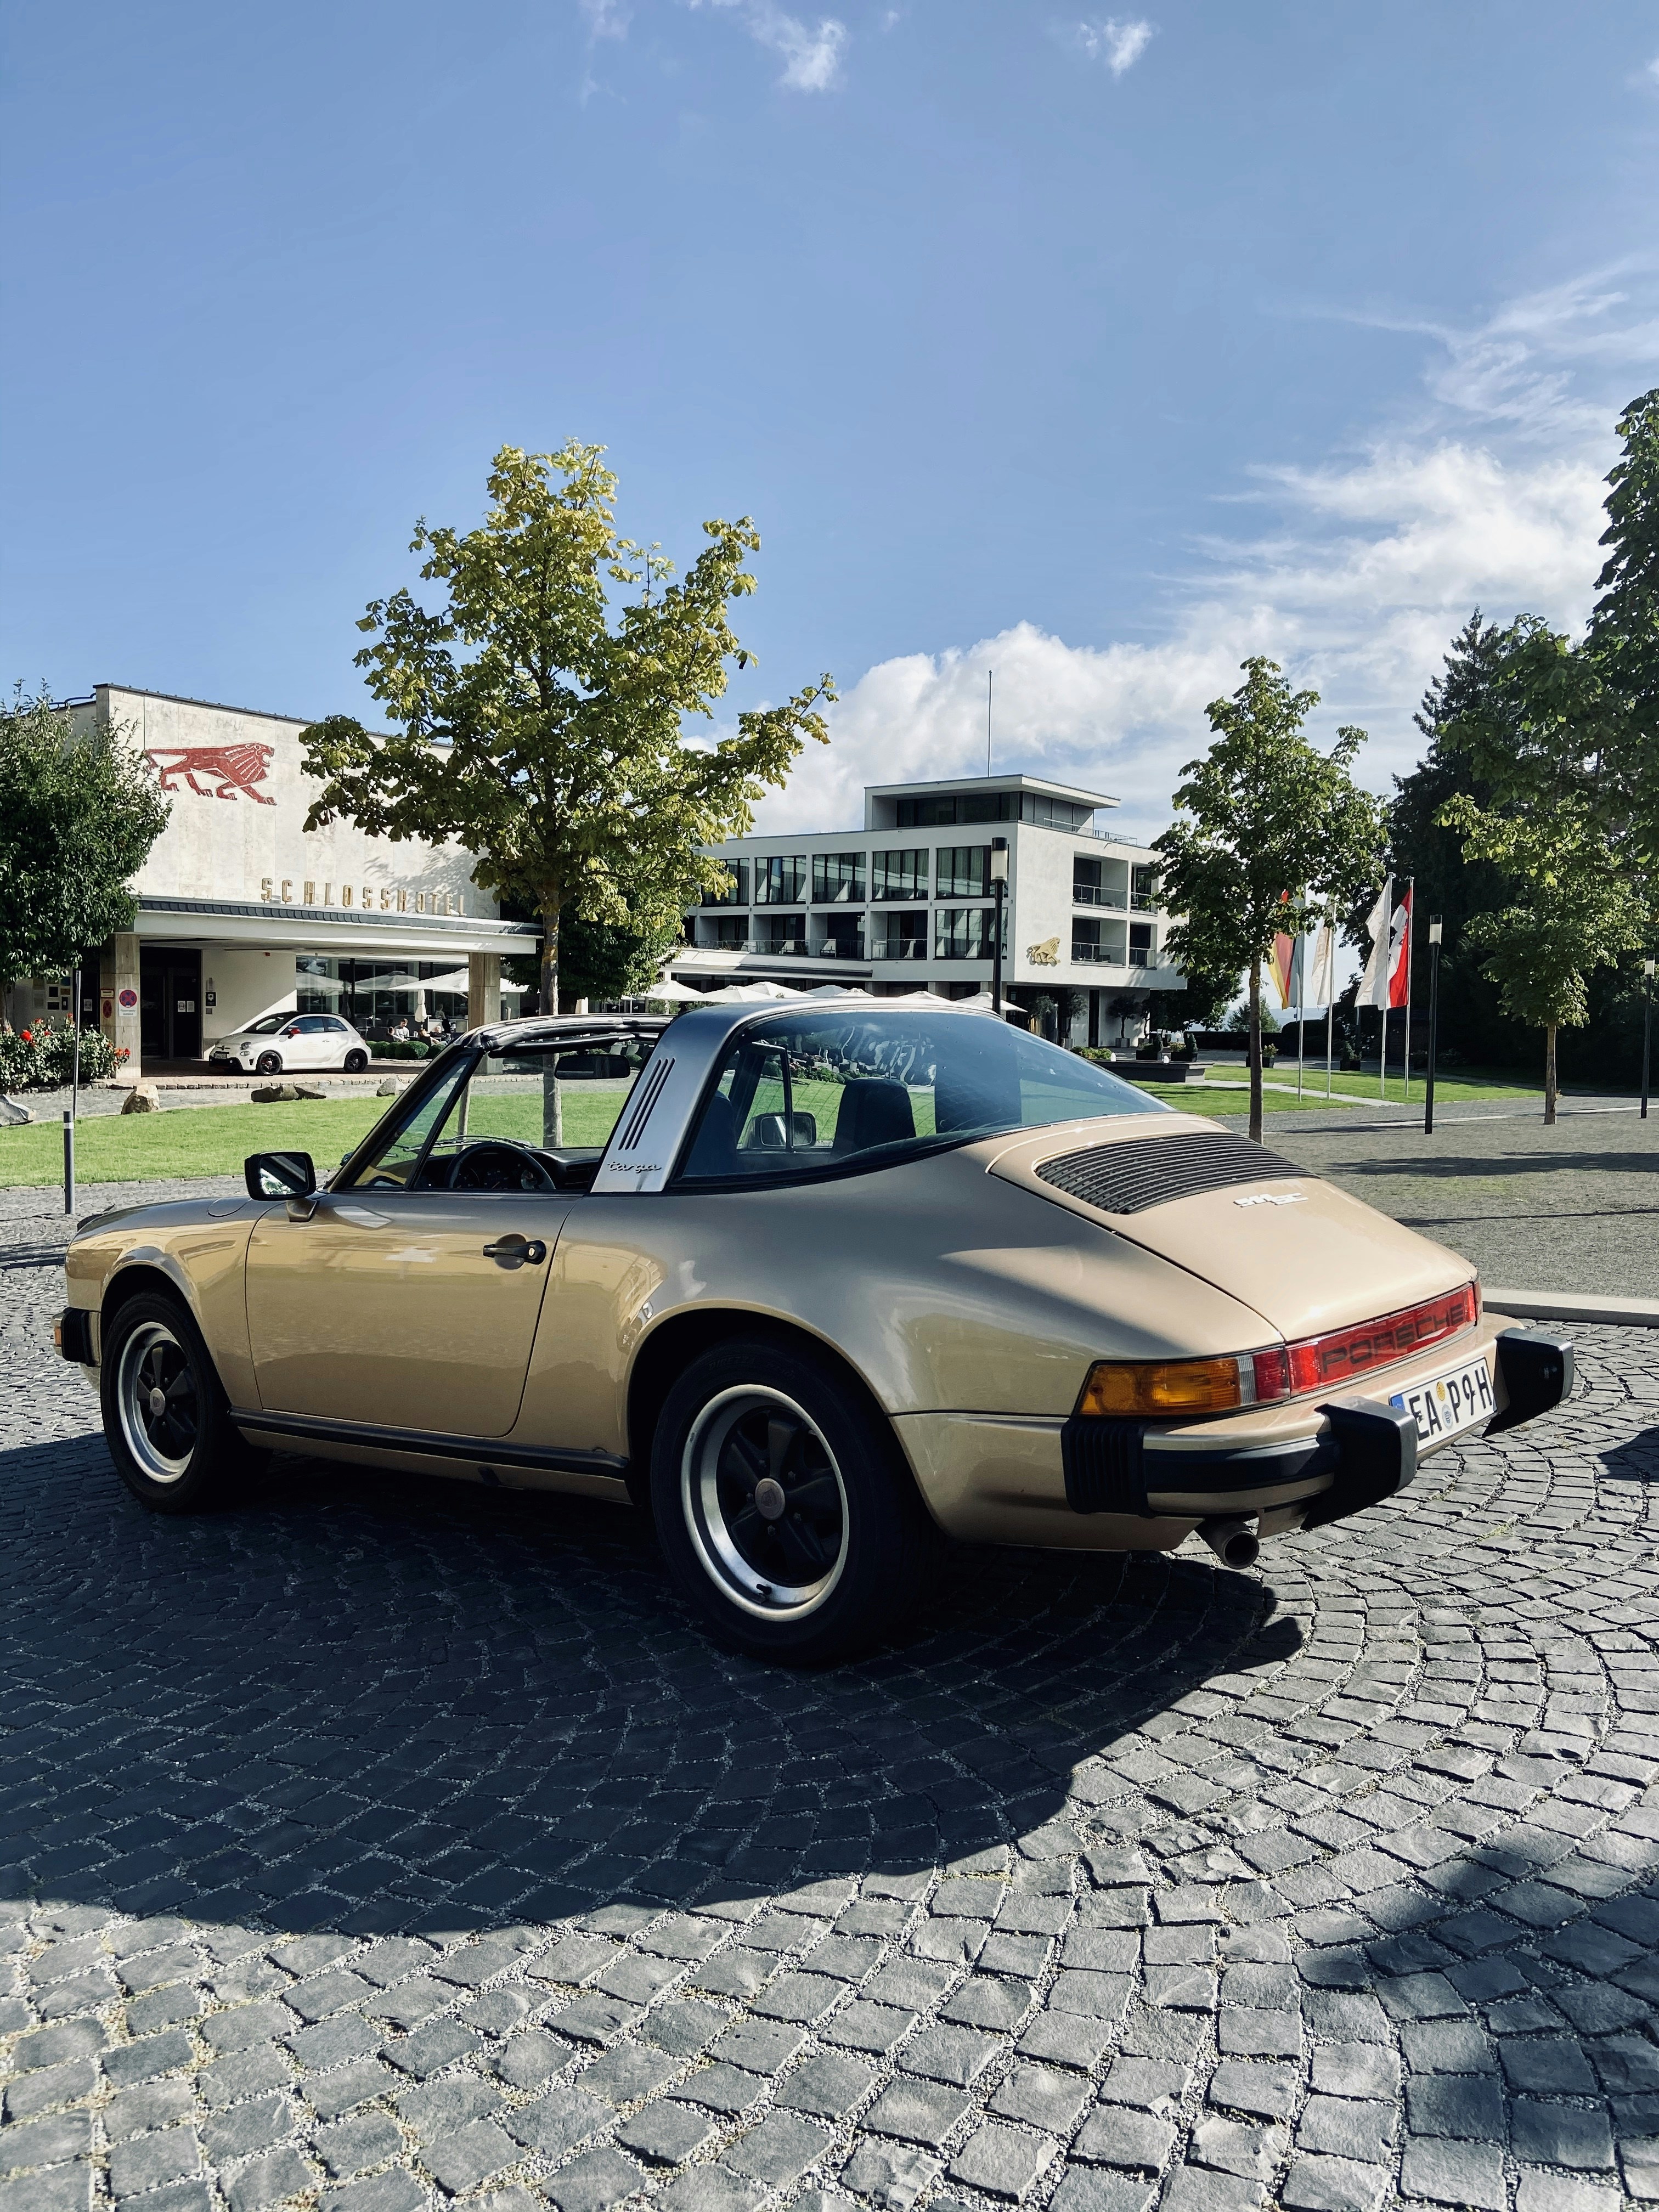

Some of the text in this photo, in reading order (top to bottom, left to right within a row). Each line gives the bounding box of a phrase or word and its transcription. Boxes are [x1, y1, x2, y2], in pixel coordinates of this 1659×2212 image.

[261, 878, 467, 917] SCHLOSSHOTEL
[607, 1161, 662, 1173] targa
[1322, 1302, 1464, 1374] PORSCHE
[1408, 1390, 1442, 1441] EA
